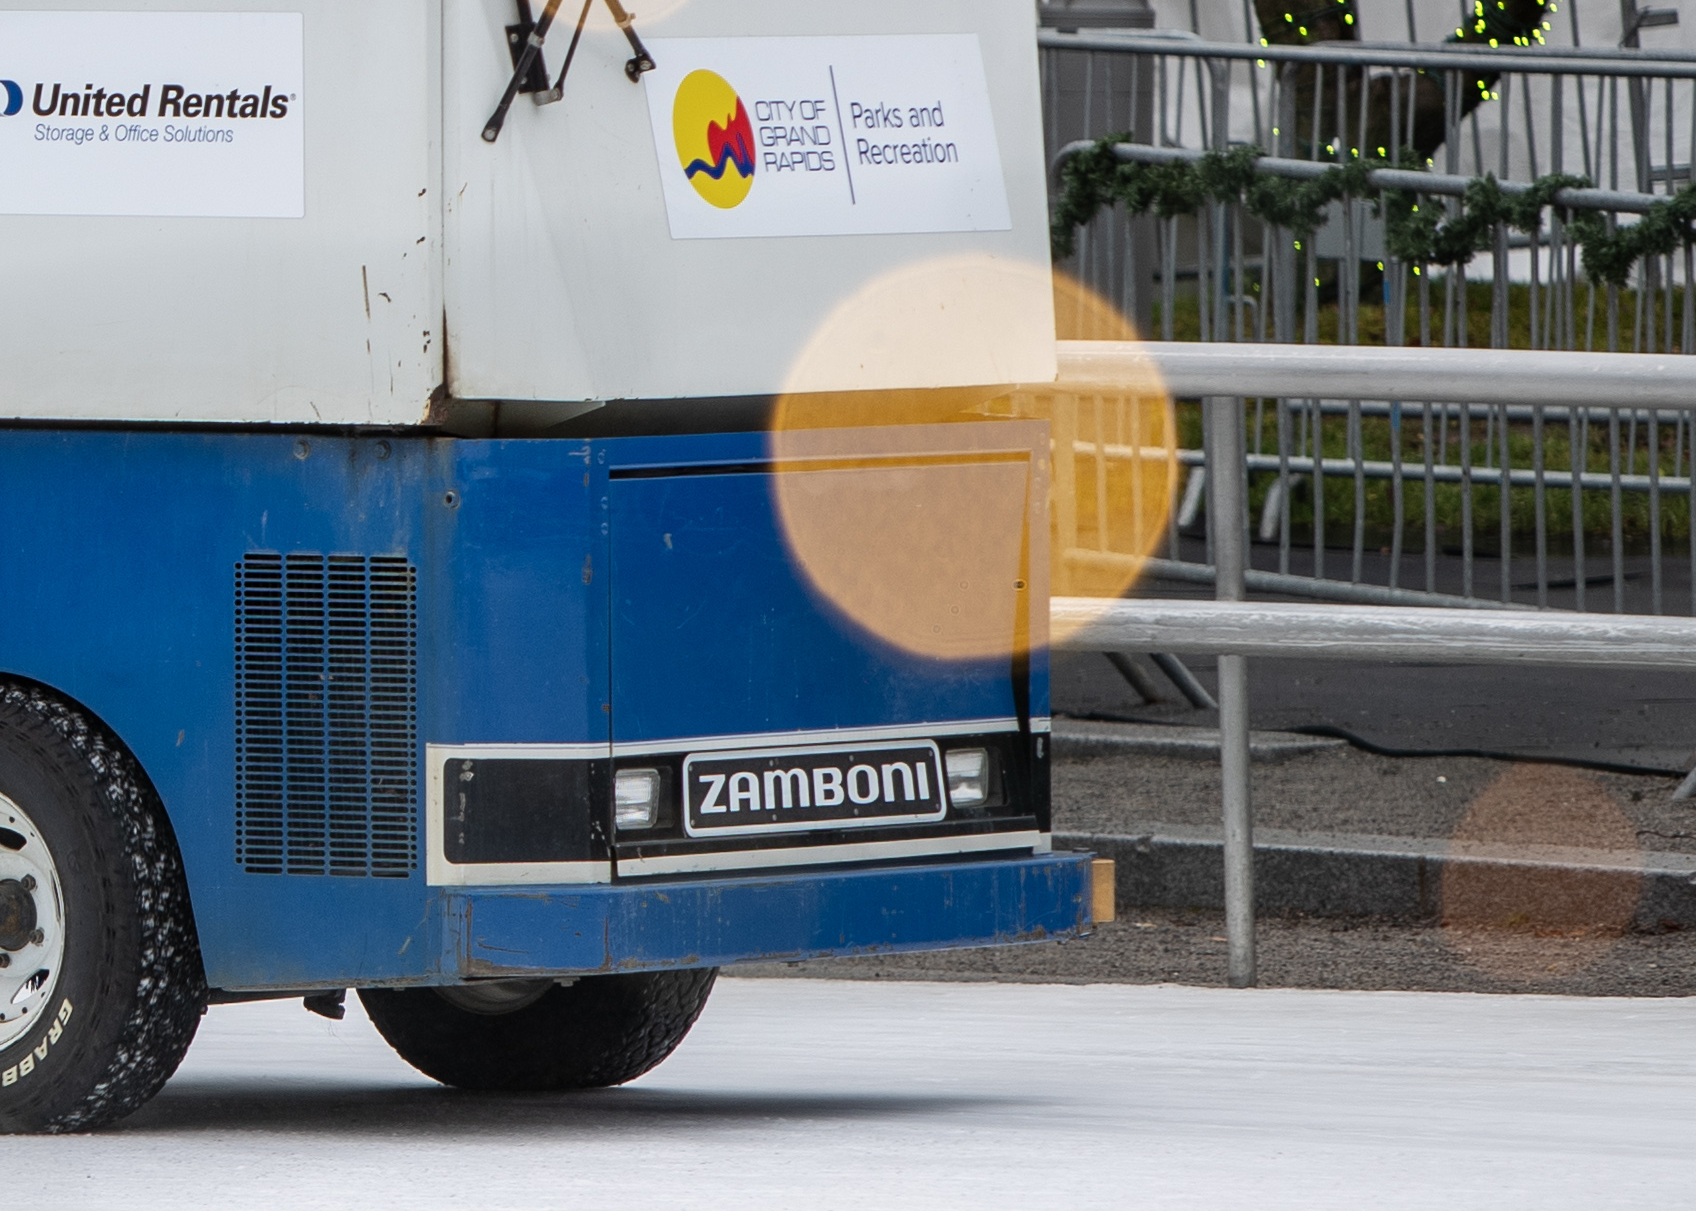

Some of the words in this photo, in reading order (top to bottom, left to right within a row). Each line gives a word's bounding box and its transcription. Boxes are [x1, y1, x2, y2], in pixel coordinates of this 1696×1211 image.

[32, 82, 151, 117] United
[754, 100, 798, 122] CITY
[799, 99, 826, 121] OF
[850, 100, 903, 129] Parks
[909, 100, 945, 128] and
[34, 123, 94, 145] Storage
[99, 124, 110, 142] &
[115, 124, 159, 142] Office
[163, 124, 234, 143] Solutions
[759, 125, 832, 147] GRAND
[763, 150, 836, 172] RAPIDS
[857, 136, 959, 166] Recreation
[698, 761, 930, 814] ZAMBONI
